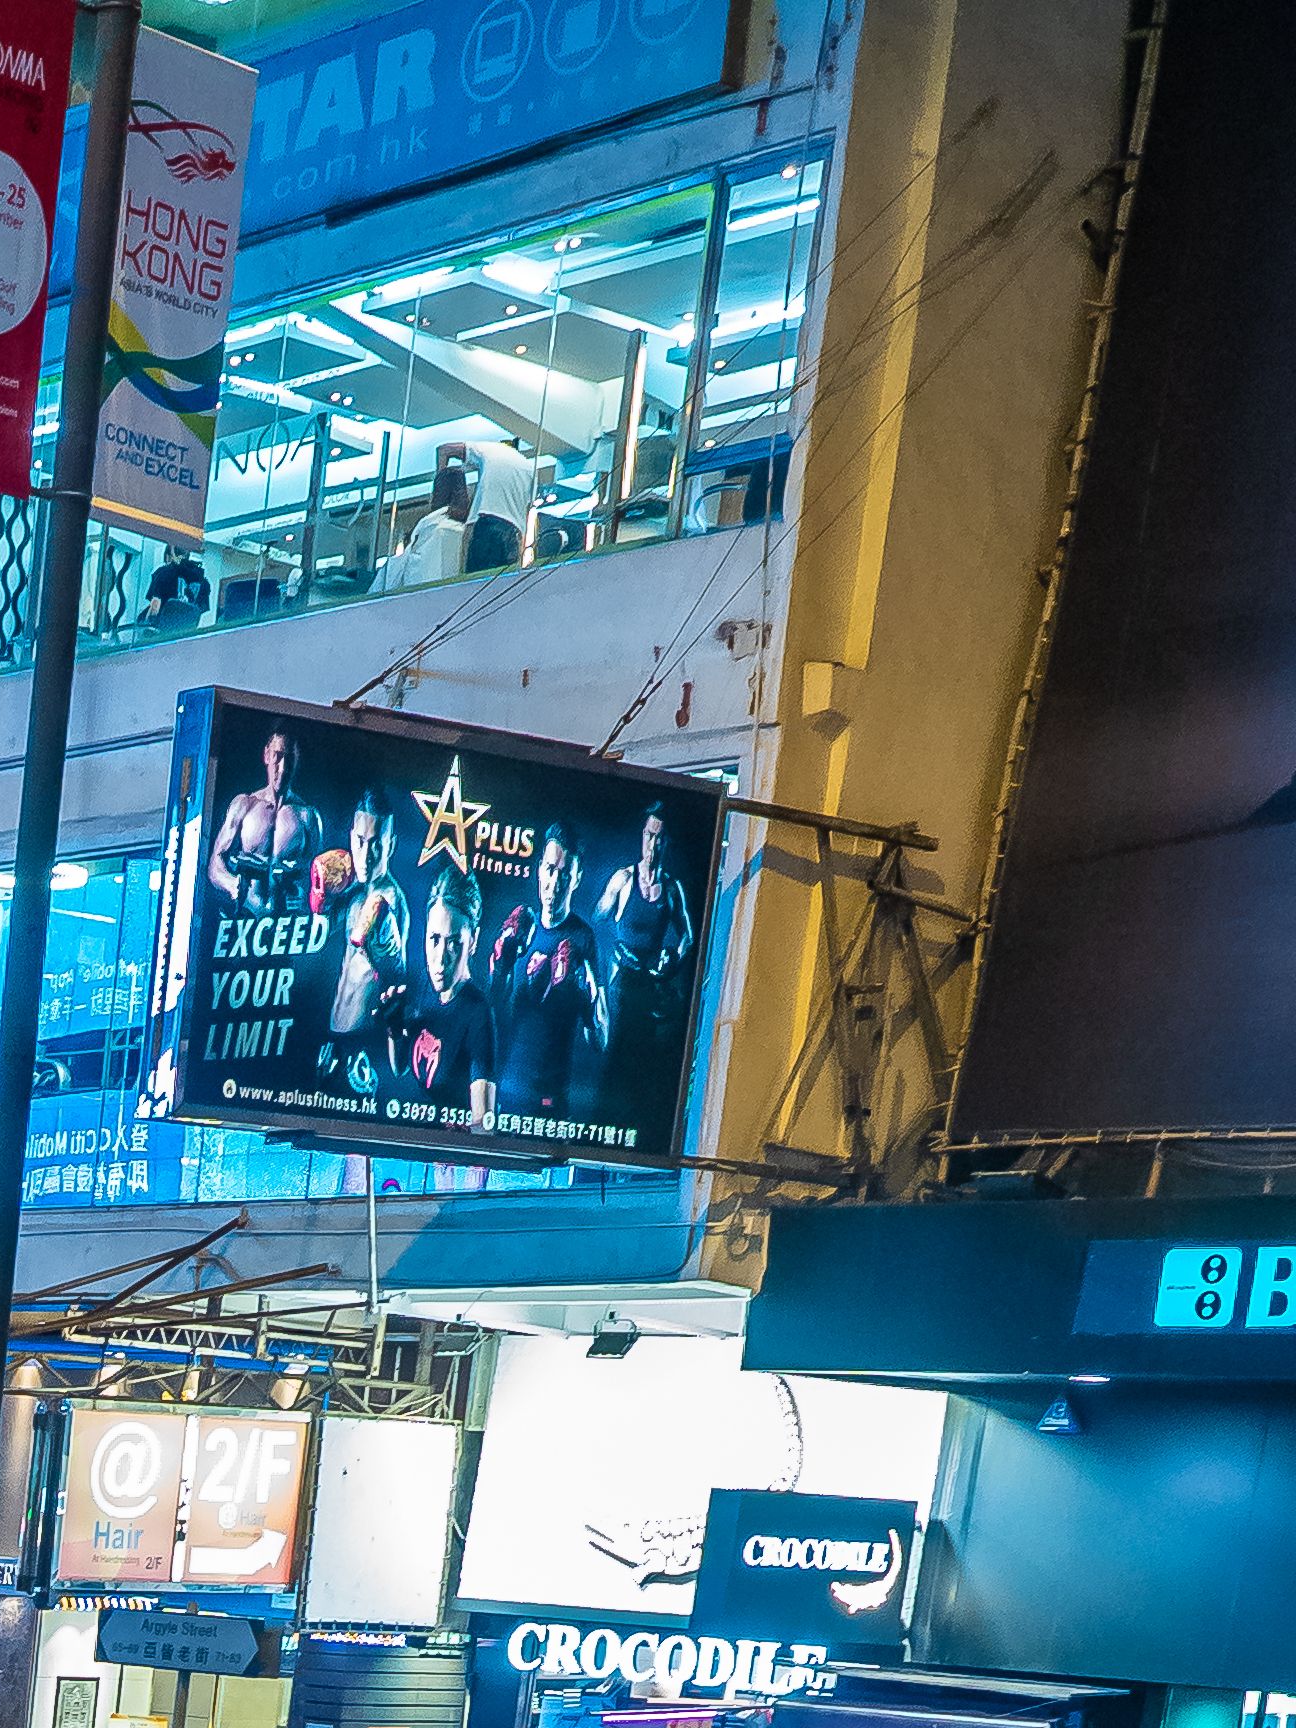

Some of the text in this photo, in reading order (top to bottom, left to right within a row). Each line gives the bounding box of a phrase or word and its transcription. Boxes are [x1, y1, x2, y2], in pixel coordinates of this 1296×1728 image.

[256, 25, 434, 160] TAR
[6, 182, 27, 209] 25
[125, 189, 229, 260] HONG
[121, 233, 224, 301] KONG
[154, 289, 192, 313] WORLD
[193, 302, 219, 319] CITY
[105, 423, 189, 464] CONNECT
[115, 448, 200, 490] AND EXCEL
[475, 822, 534, 858] PLUS
[473, 853, 531, 879] fitness
[213, 913, 329, 960] EXCEED
[212, 968, 293, 1010] YOUR
[204, 1019, 294, 1062] LIMIT
[239, 1087, 378, 1116] www.aplusfitness.hk
[440, 1107, 473, 1127] 3539
[198, 1427, 298, 1507] 2/F
[94, 1520, 144, 1550] Hair
[742, 1534, 889, 1574] CROCODILE
[145, 1556, 163, 1570] 2/F
[141, 1617, 219, 1639] Argyle Street
[143, 1641, 210, 1665] 亞皆老街
[509, 1623, 830, 1697] CROCODILE
